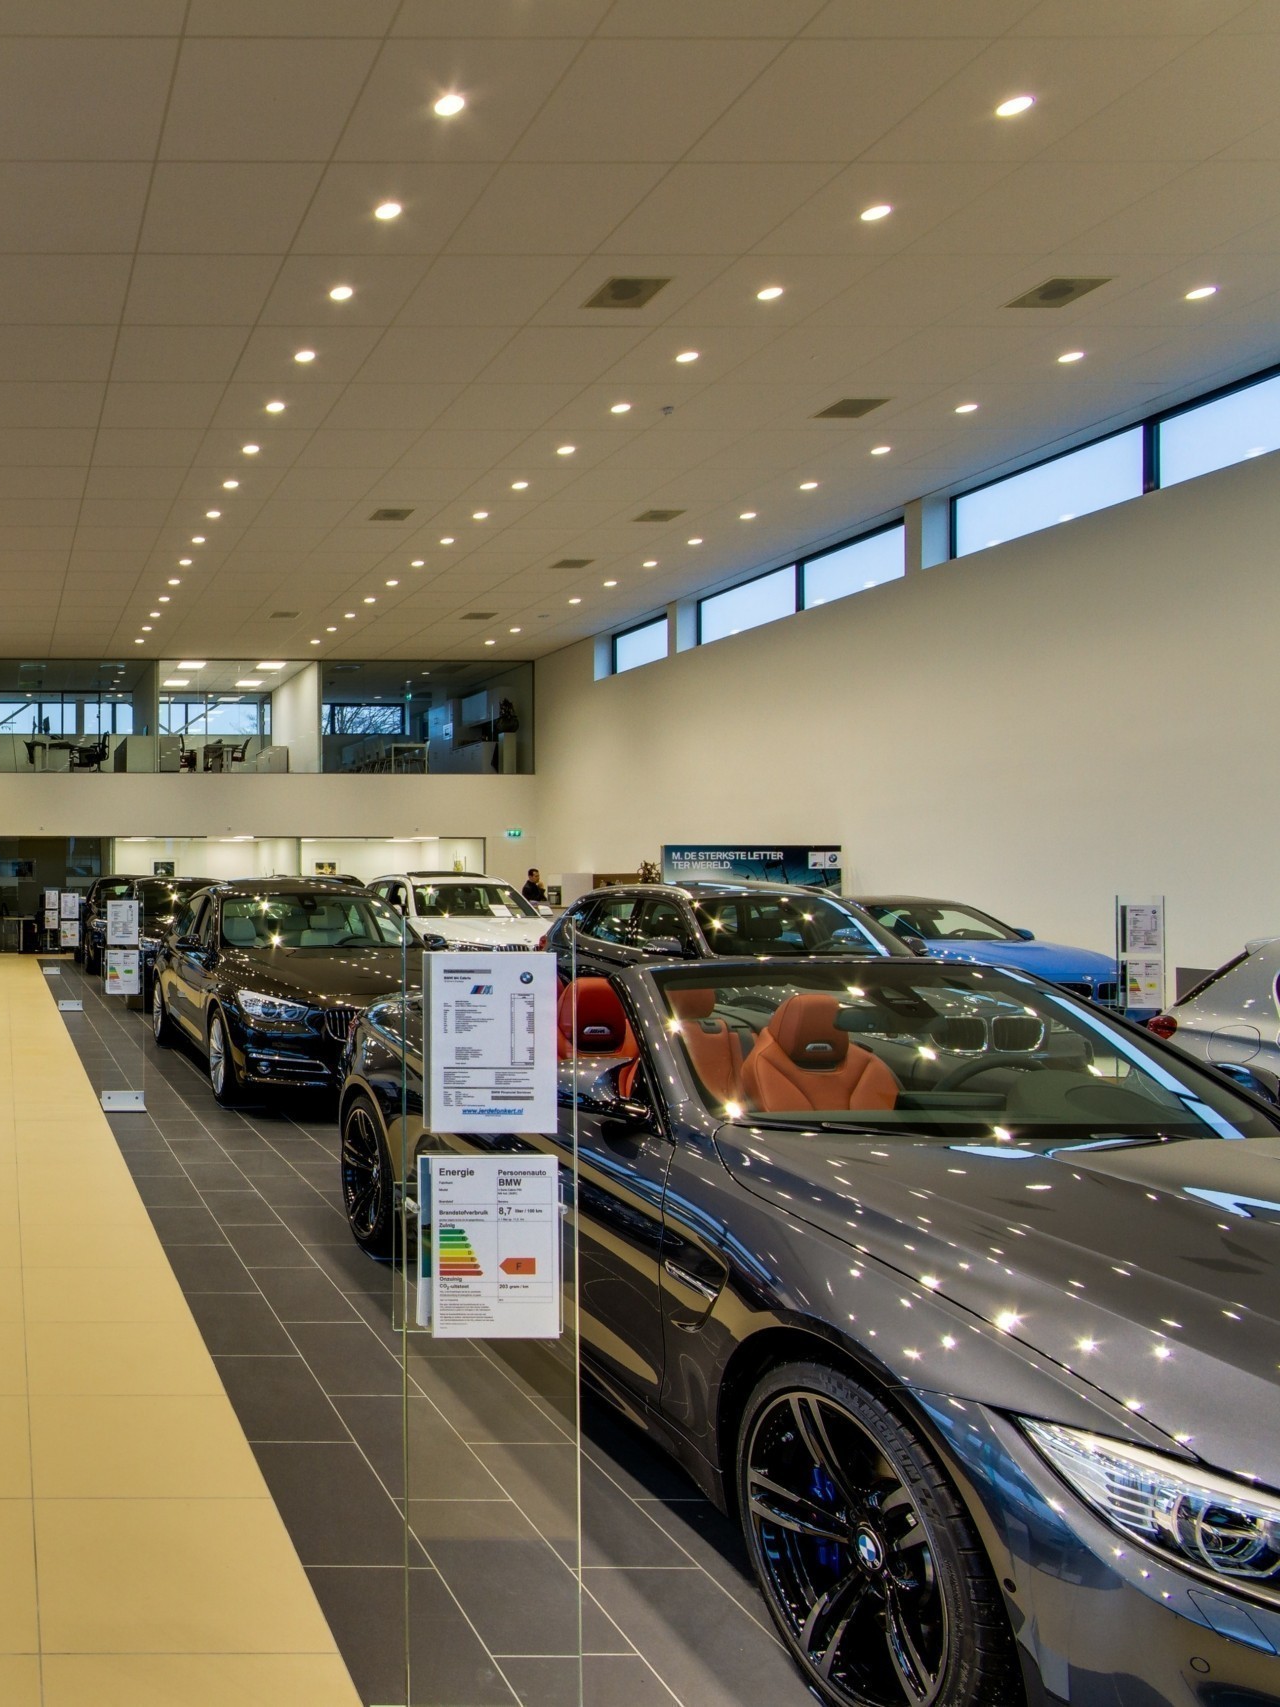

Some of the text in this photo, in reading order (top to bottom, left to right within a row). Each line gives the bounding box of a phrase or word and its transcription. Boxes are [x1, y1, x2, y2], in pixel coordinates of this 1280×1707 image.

[672, 851, 784, 860] M. DE STERKSTE LETTER
[672, 861, 733, 870] TER WERELD.
[438, 1167, 475, 1178] Energie
[498, 1178, 522, 1187] BMW
[498, 1207, 512, 1217] 8,7
[516, 1262, 522, 1271] F
[860, 1402, 921, 1484] MICHELIN
